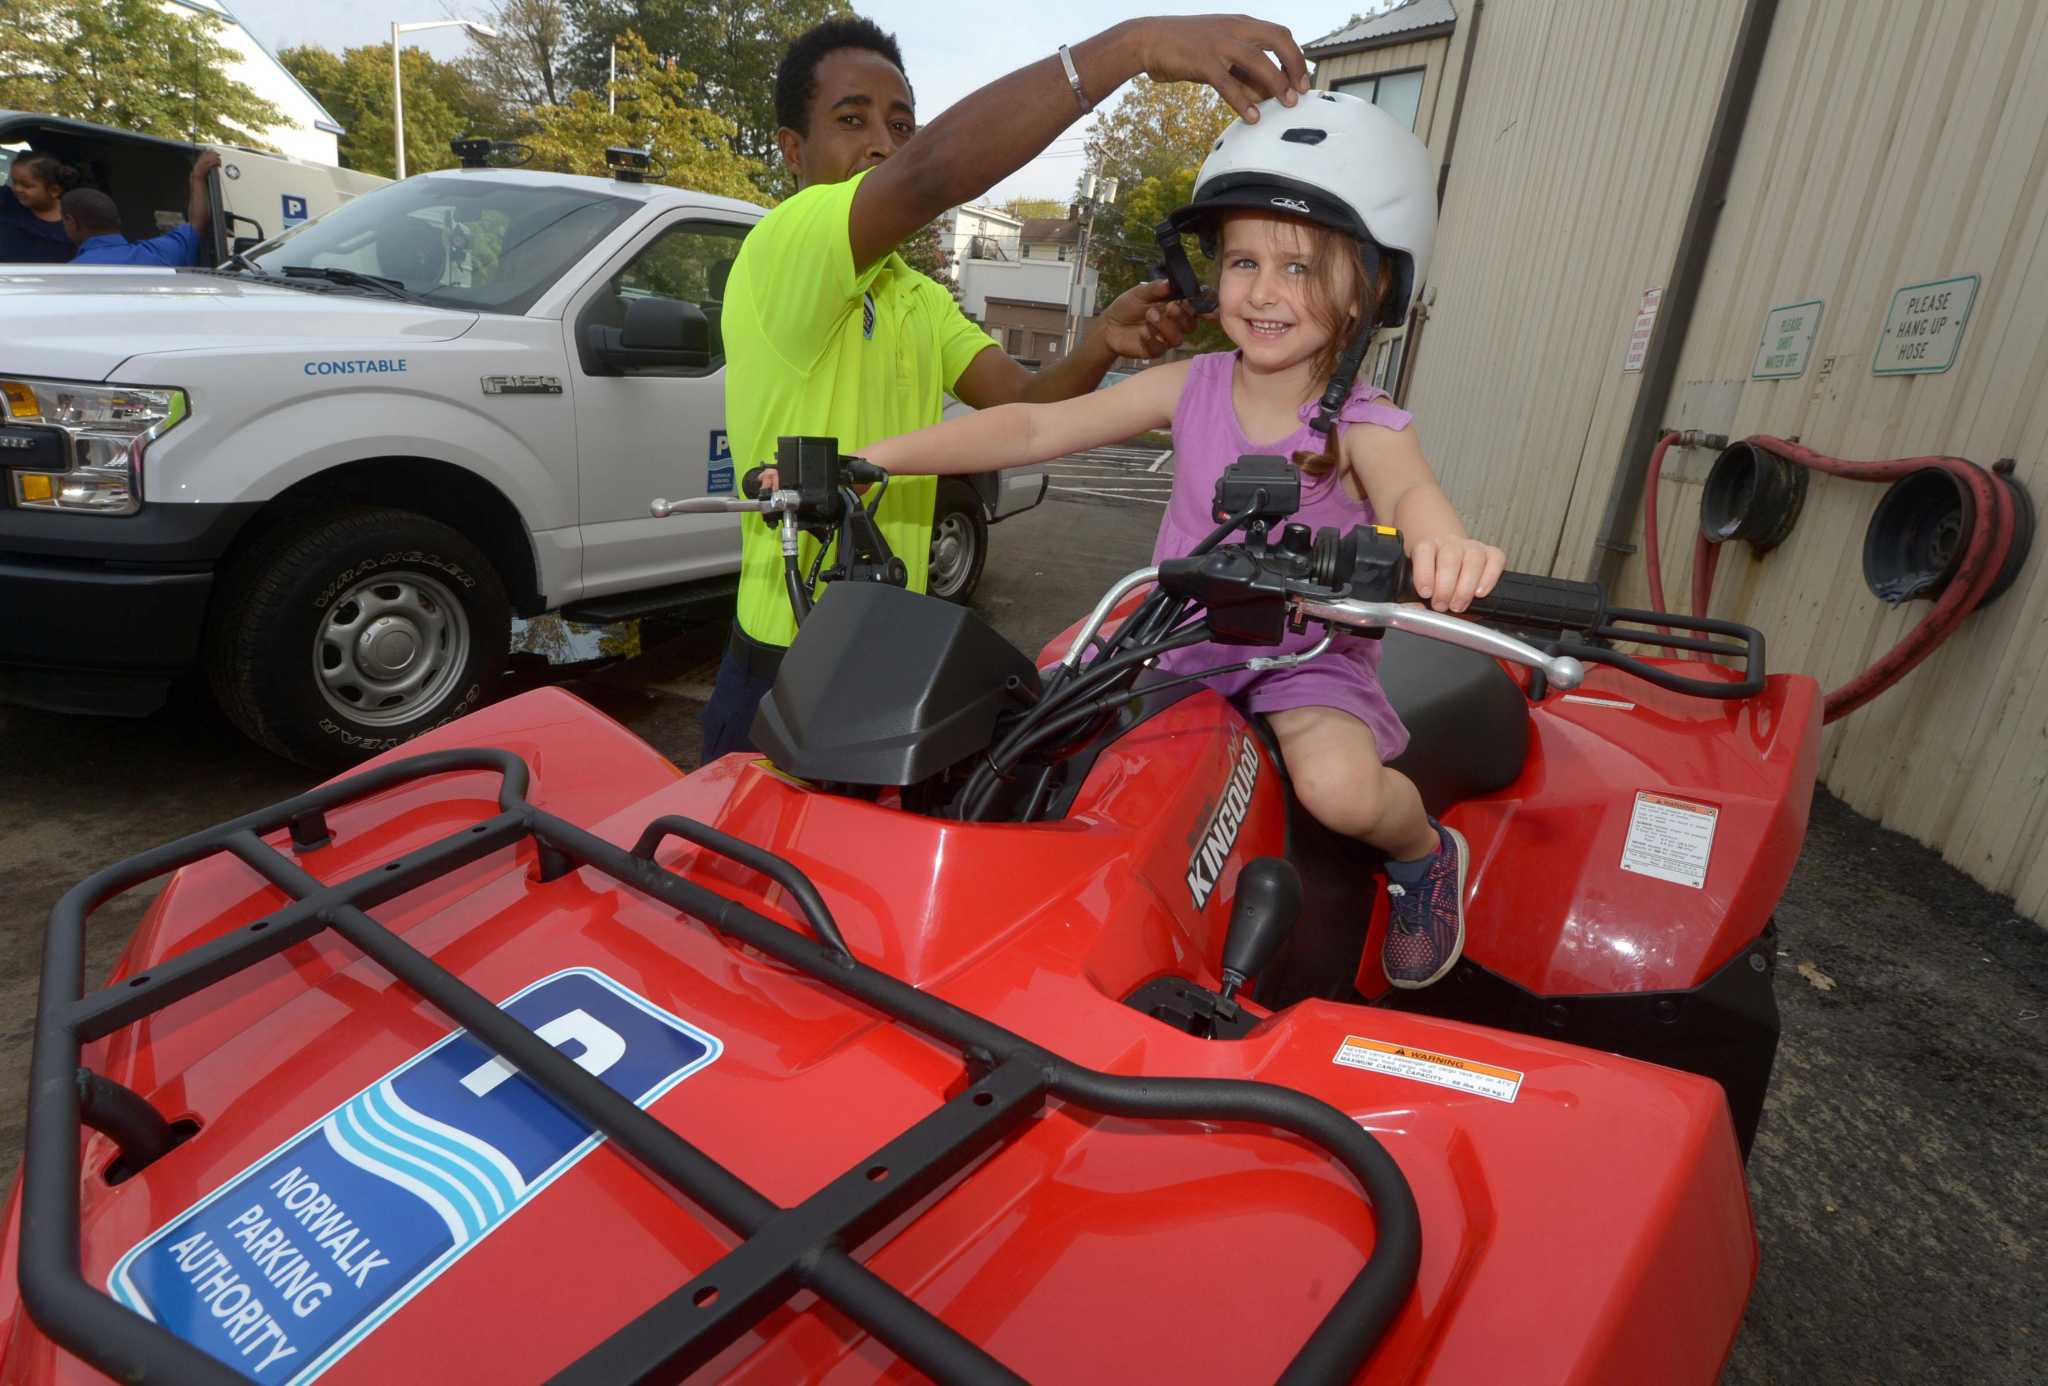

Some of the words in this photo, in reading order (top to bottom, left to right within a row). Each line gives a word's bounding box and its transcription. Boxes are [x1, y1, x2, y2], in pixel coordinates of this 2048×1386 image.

[288, 199, 302, 216] P
[1906, 292, 1952, 314] PLEASE
[1896, 319, 1929, 337] HANG
[1930, 316, 1948, 335] UP
[1898, 341, 1929, 360] HOSE
[304, 359, 407, 375] CONSTABLE
[716, 435, 729, 456] P
[315, 552, 476, 607] WRANGLER
[1187, 735, 1259, 910] KINGQUAD
[459, 1008, 627, 1098] P
[1411, 1051, 1465, 1069] WARNING
[1376, 1063, 1402, 1073] CARGO
[1406, 1067, 1443, 1080] CAPACITY
[269, 1166, 391, 1289] NORWALK
[226, 1204, 333, 1318] PARKING
[168, 1231, 298, 1373] AUTHORITY
